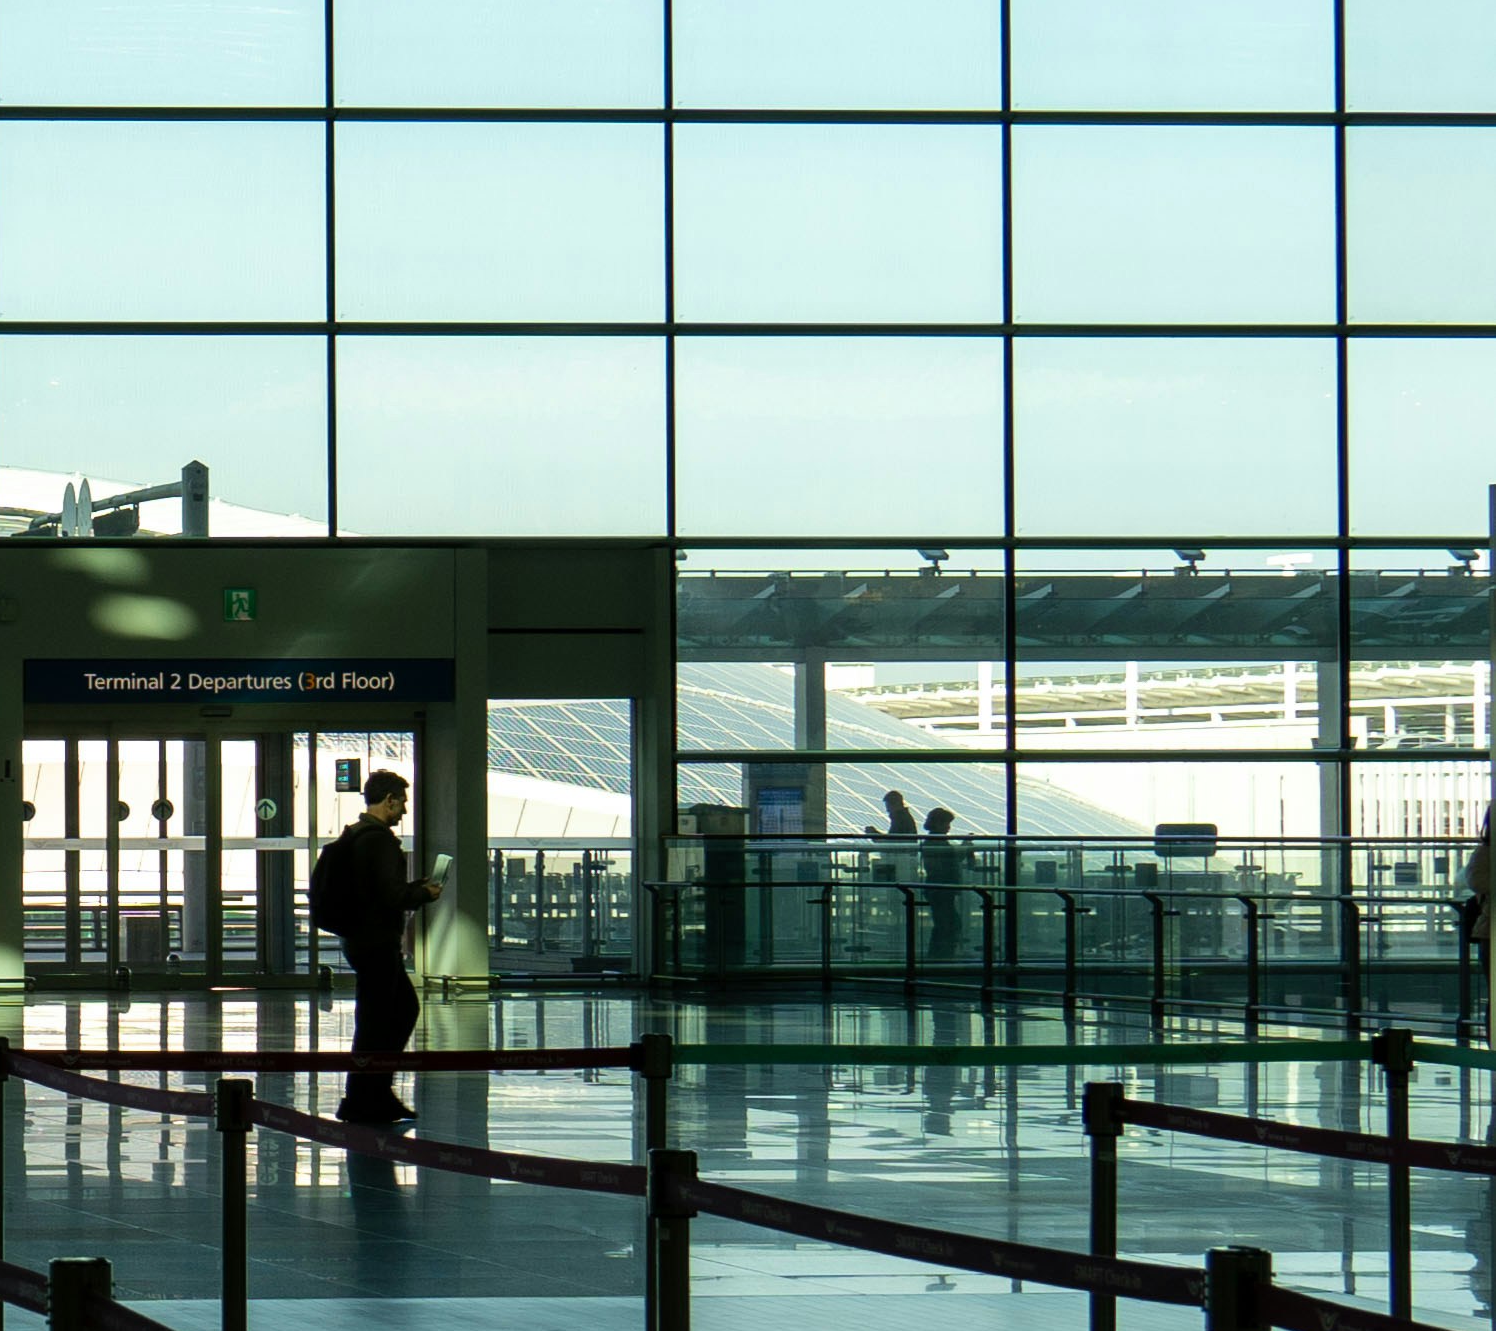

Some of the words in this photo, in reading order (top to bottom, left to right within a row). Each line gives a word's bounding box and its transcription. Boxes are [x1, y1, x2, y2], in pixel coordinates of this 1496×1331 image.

[83, 672, 164, 691] Terminal
[169, 673, 182, 691] 2
[187, 672, 293, 695] Departures
[297, 671, 336, 693] (3rd
[341, 671, 396, 693] Floor)
